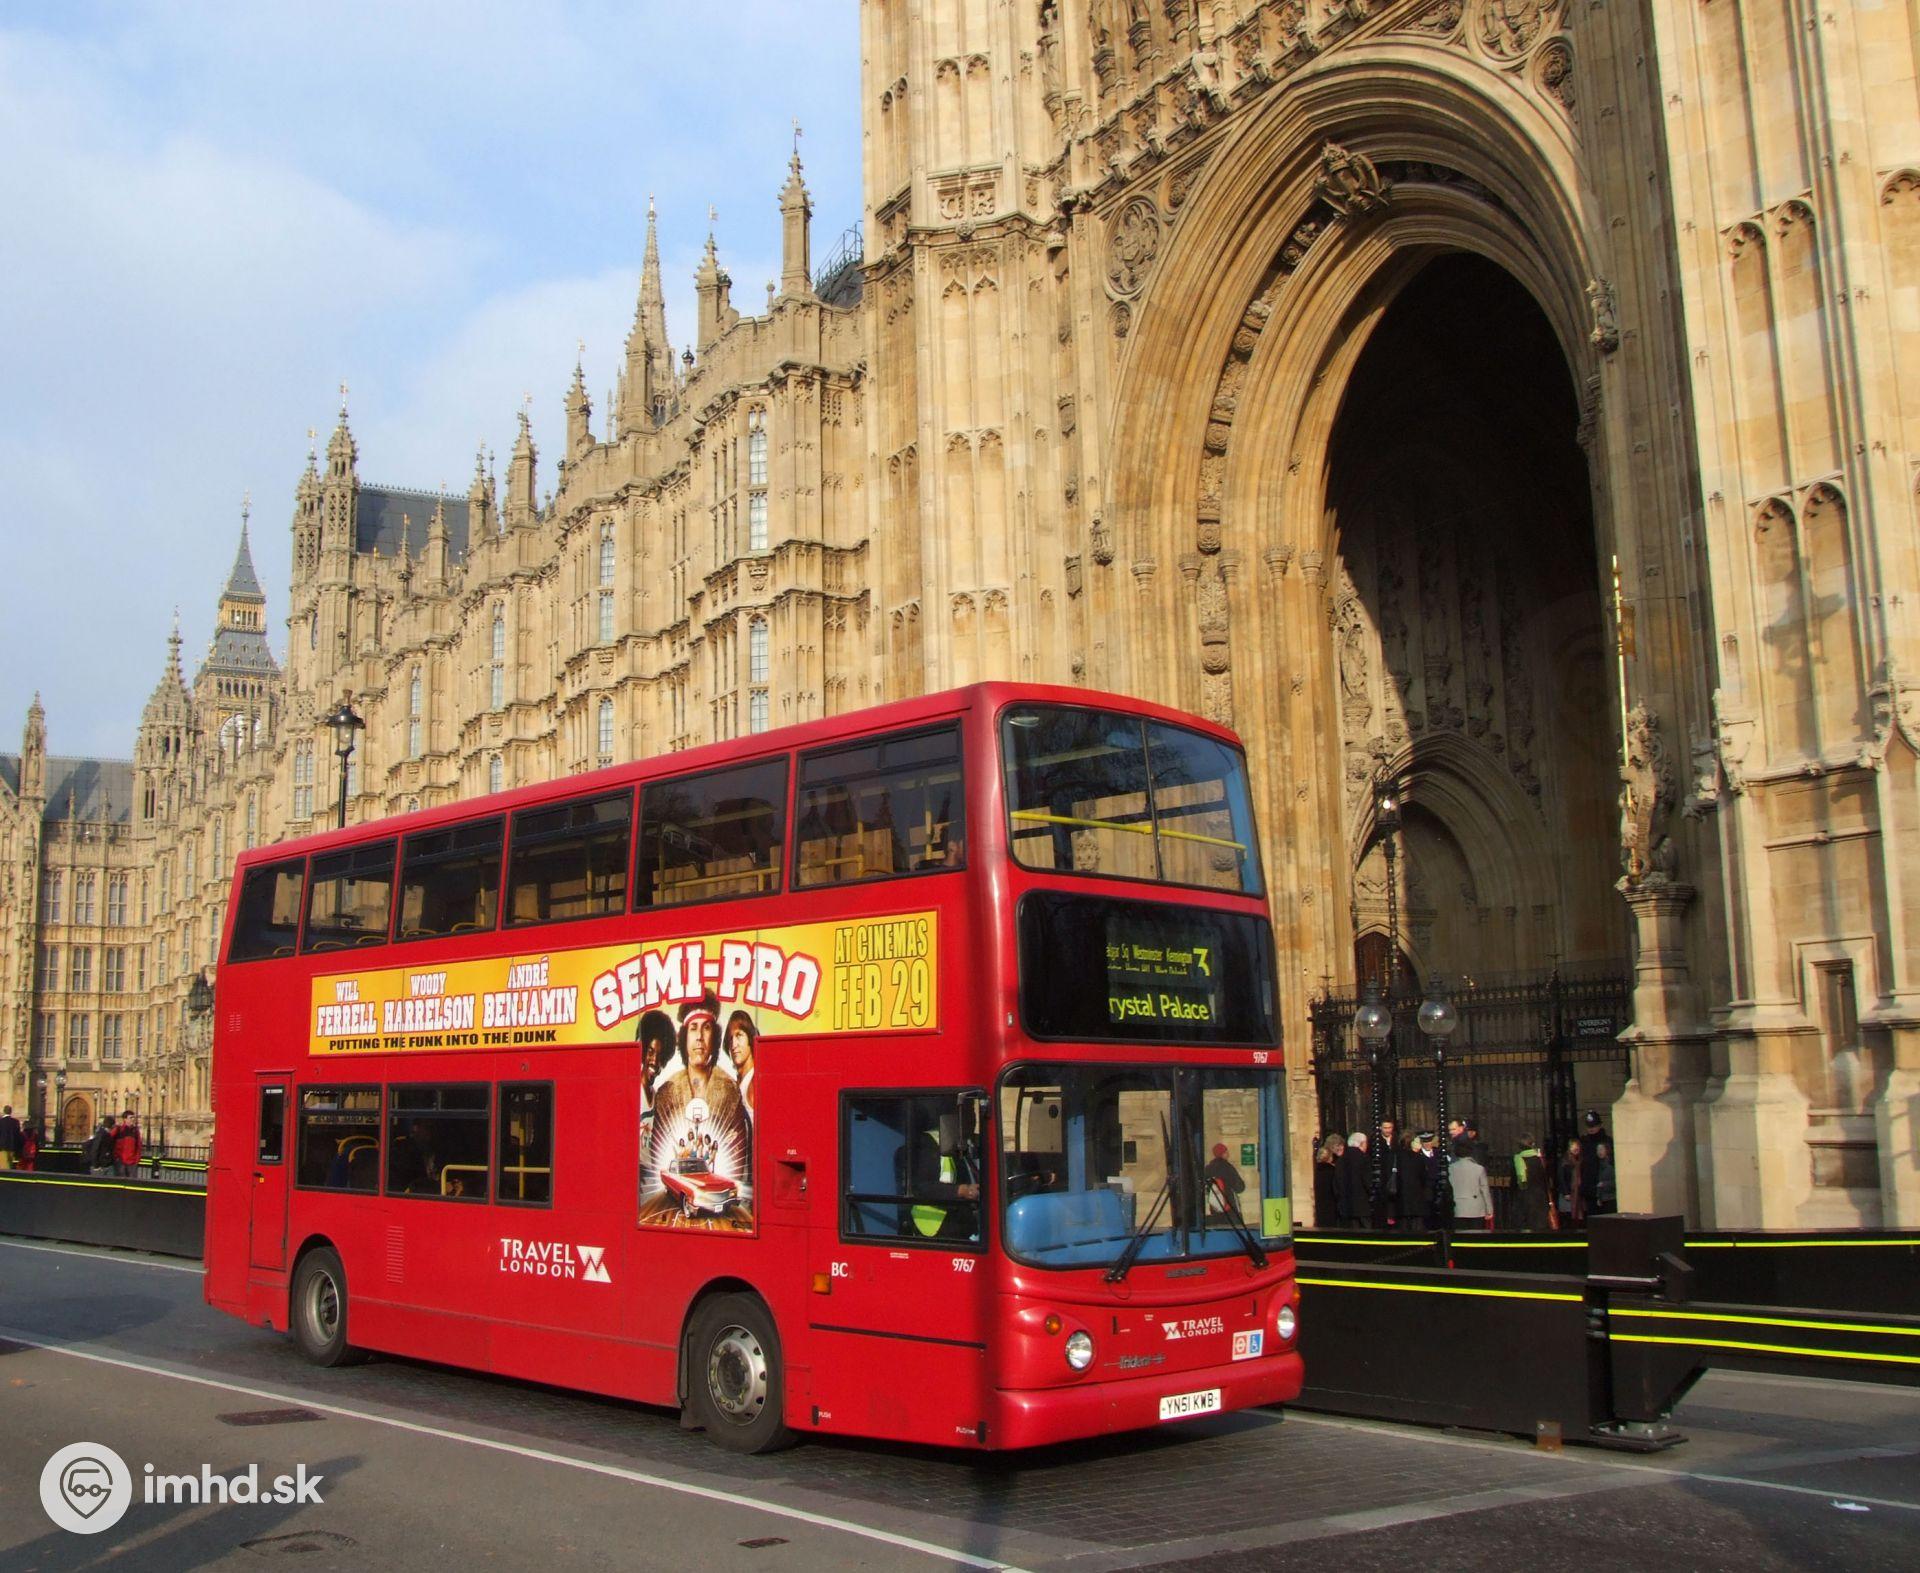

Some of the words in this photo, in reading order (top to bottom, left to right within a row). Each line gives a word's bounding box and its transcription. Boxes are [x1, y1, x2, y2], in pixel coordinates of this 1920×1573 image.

[833, 926, 853, 965] AT
[856, 918, 928, 960] CINEMAS
[507, 956, 549, 989] ANDRÉ
[336, 980, 360, 1002] WILL
[410, 972, 447, 997] WOODY
[591, 940, 822, 1031] SEMI-PRO
[833, 963, 882, 1031] FEB
[890, 958, 930, 1027] 29
[316, 1002, 378, 1037] FERRELL
[383, 994, 476, 1034] HARRELSON
[482, 986, 579, 1029] BENJAMIN
[1108, 993, 1156, 1020] rystal
[1160, 994, 1209, 1020] Palace
[329, 1038, 380, 1051] PUTTING
[383, 1037, 406, 1049] THE
[409, 1035, 443, 1047] FUNK
[446, 1033, 479, 1046] INTO
[482, 1032, 510, 1045] THE
[513, 1030, 557, 1043] DUNK
[500, 1238, 575, 1264] TRAVEL
[500, 1258, 575, 1279] LONDON
[831, 1262, 848, 1278] BC
[952, 1258, 975, 1273] 9767
[1182, 1317, 1223, 1331] TRAVEL
[1182, 1326, 1224, 1338] LONDON
[1193, 1392, 1213, 1410] KWB
